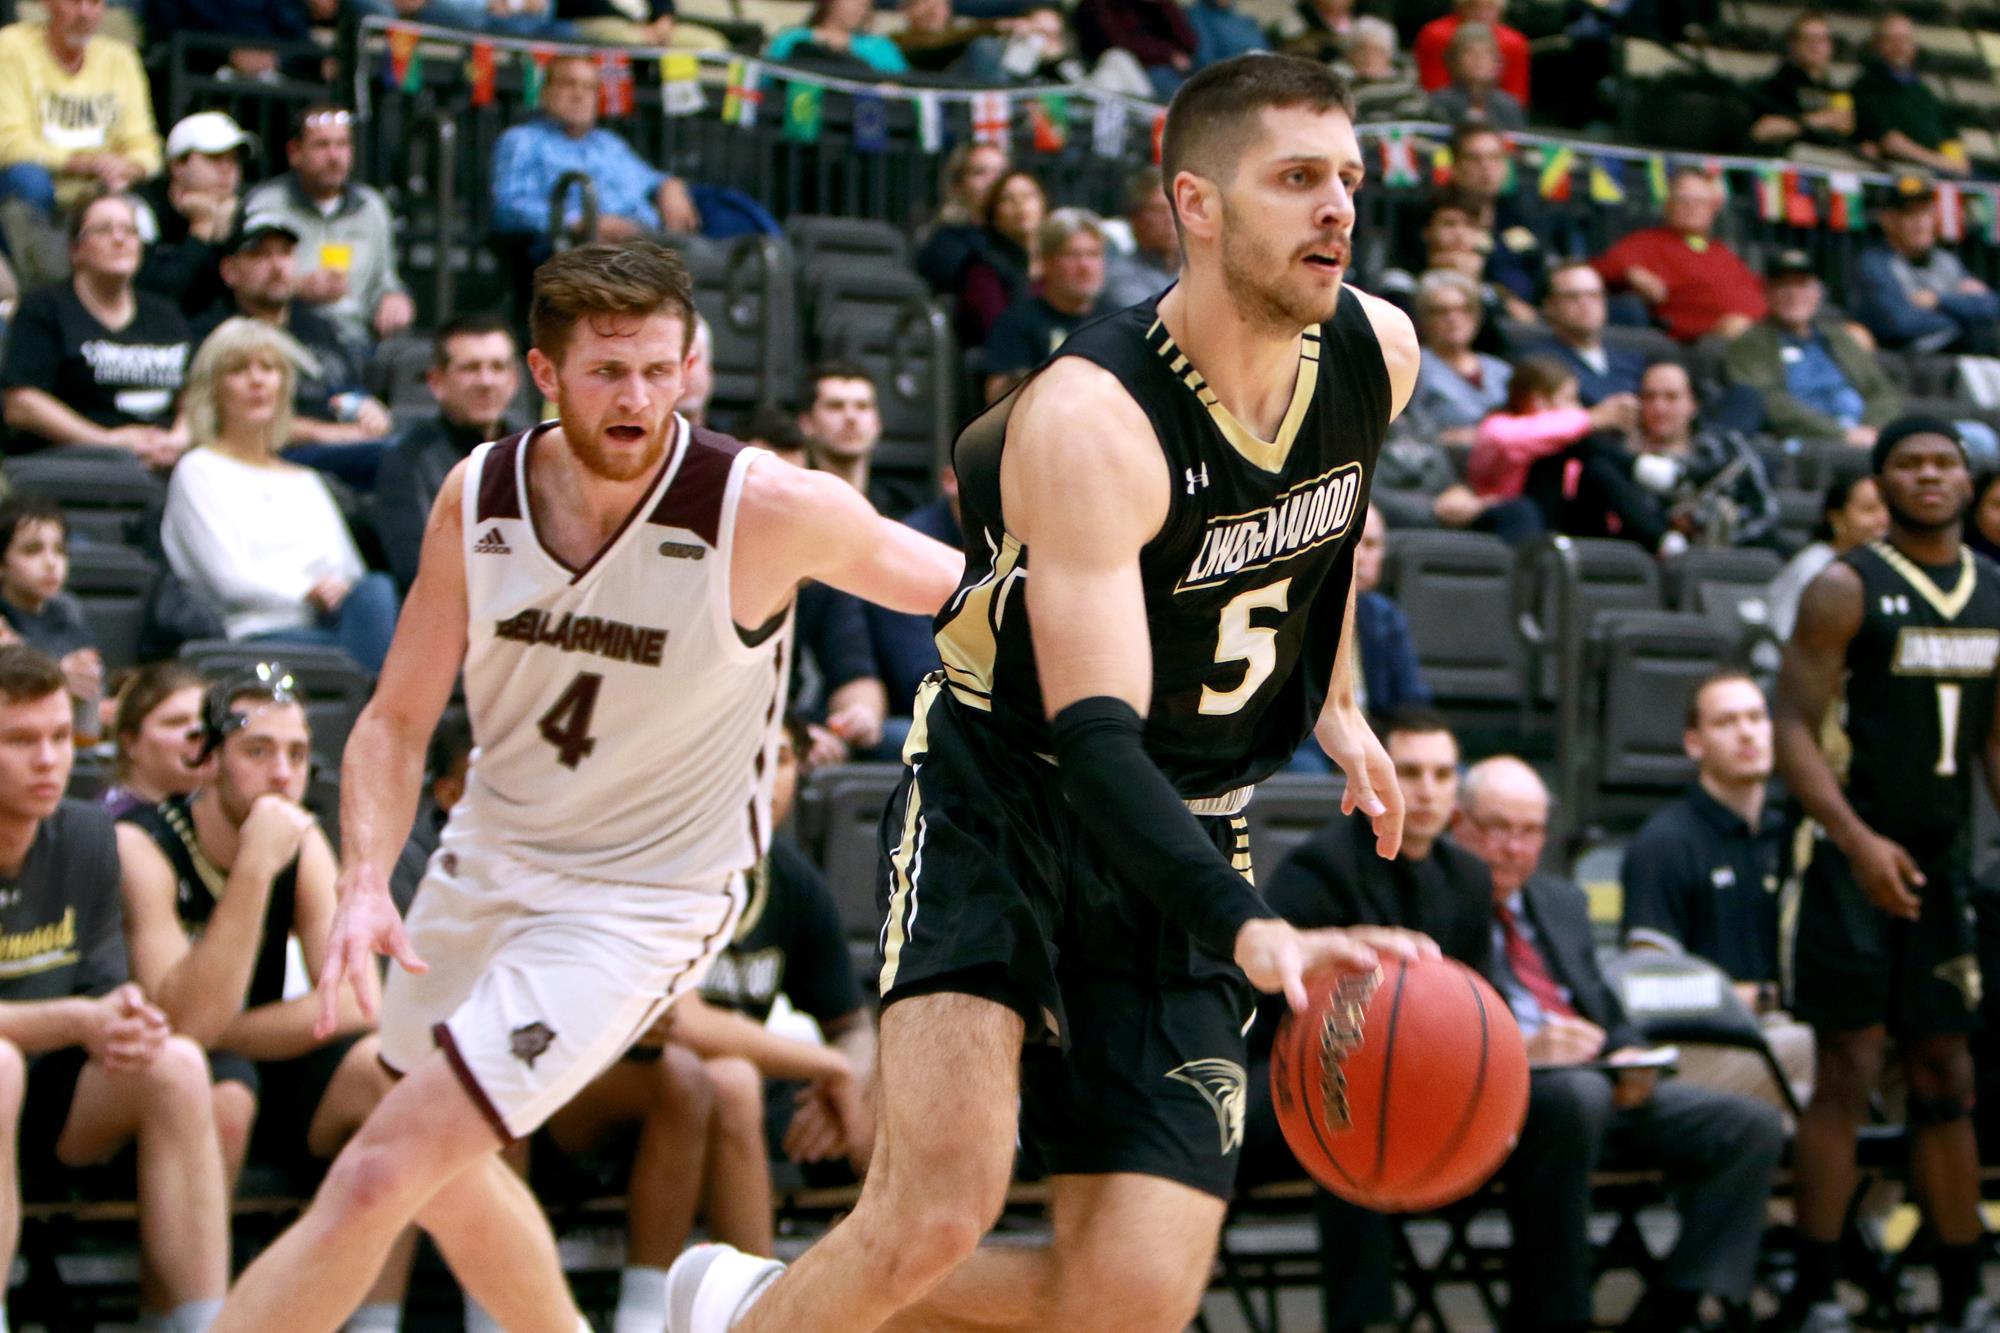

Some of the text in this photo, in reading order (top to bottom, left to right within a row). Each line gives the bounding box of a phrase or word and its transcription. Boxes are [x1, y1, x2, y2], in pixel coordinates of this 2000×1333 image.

[1197, 576, 1293, 716] 5
[536, 669, 604, 772] 4
[1934, 682, 1962, 777] 1
